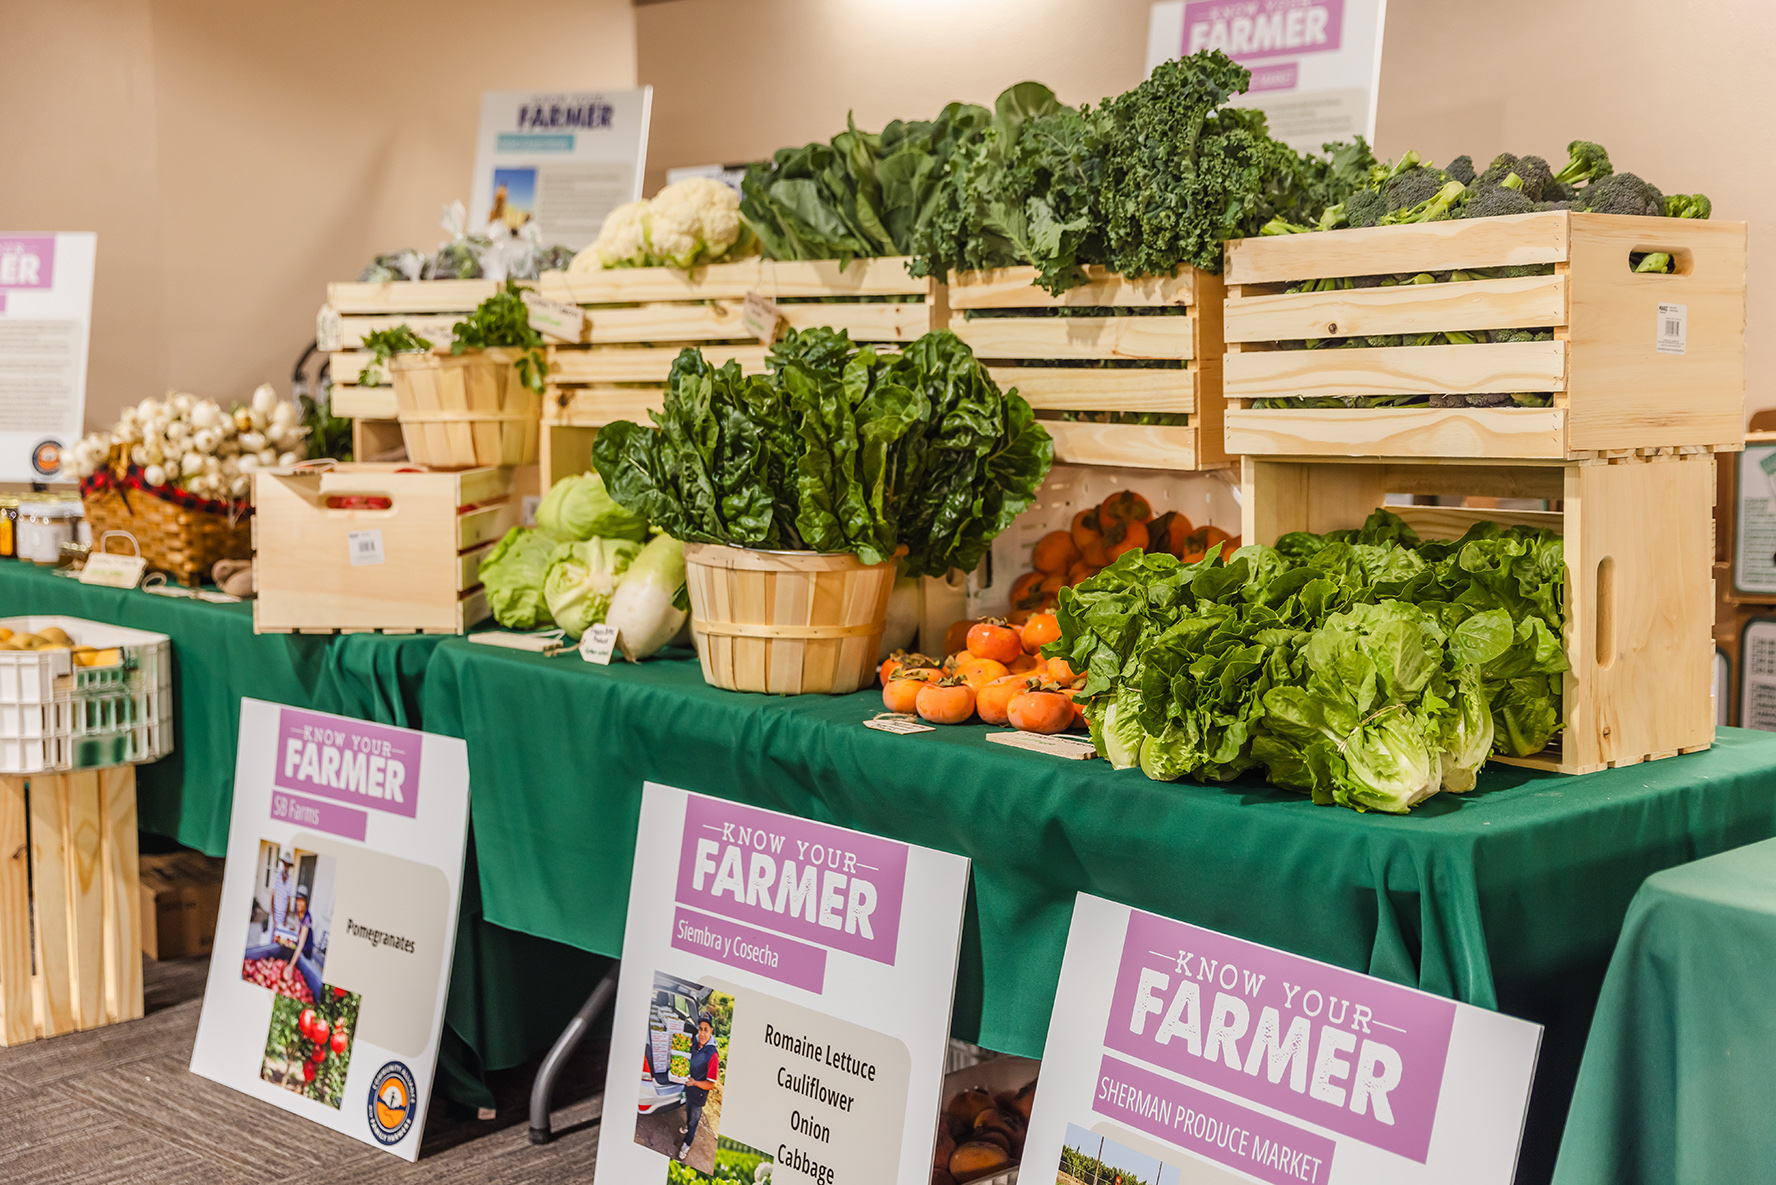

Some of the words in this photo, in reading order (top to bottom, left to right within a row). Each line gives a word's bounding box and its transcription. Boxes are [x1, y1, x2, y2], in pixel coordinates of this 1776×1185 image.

[1190, 6, 1329, 55] FARMER
[518, 103, 614, 133] FARMER
[303, 724, 346, 748] KNOW
[351, 734, 392, 757] YOUR
[284, 737, 406, 804] FARMER
[273, 795, 288, 817] SB
[288, 799, 320, 825] Farms
[722, 822, 786, 854] KNOW
[797, 840, 857, 874] YOUR
[692, 837, 878, 940] FARMER
[346, 918, 415, 954] Pomegranates
[677, 919, 722, 950] Siembra
[723, 938, 732, 958] y
[733, 936, 779, 968] Cosecha
[1175, 950, 1266, 997] KNOW
[1283, 982, 1373, 1033] YOUR
[764, 1024, 823, 1062] Romaine
[826, 1045, 876, 1081] Lettuce
[1129, 967, 1403, 1126] FARMER
[777, 1066, 855, 1112] Cauliflower
[790, 1110, 830, 1143] Onion
[1098, 1076, 1172, 1125] SHERMAN
[1174, 1105, 1249, 1156] PRODUCE
[1251, 1135, 1322, 1183] MARKET
[777, 1144, 835, 1185] Cabbage
